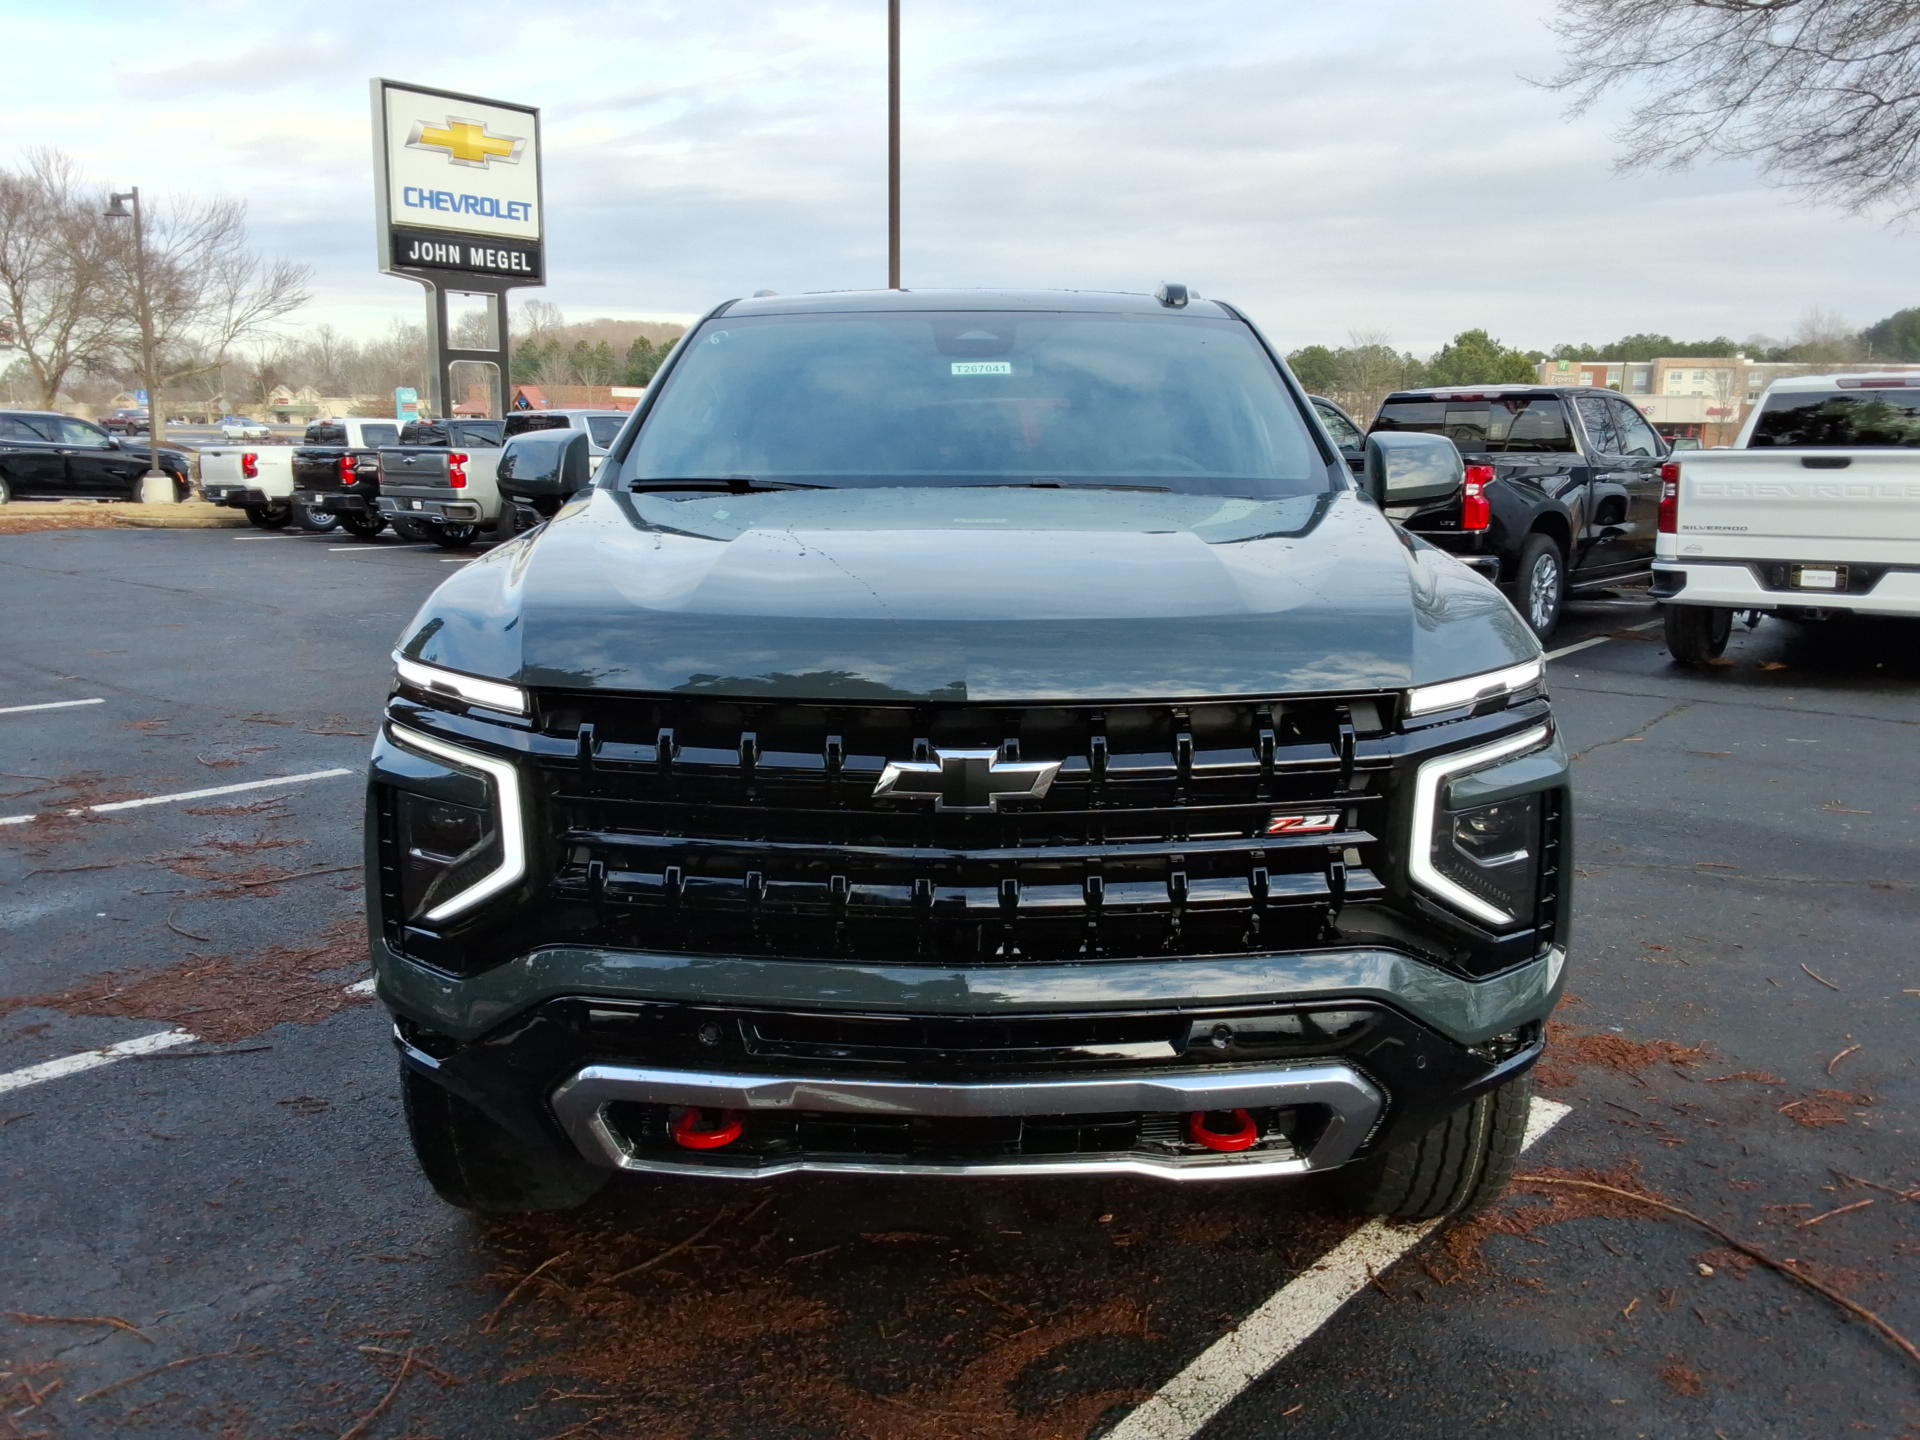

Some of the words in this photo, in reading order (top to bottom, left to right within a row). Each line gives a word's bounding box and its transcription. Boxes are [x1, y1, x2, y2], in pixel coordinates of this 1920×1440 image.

[403, 186, 532, 222] CHEVROLET
[409, 240, 460, 264] JOHN
[470, 247, 532, 271] MEGEL
[955, 364, 1007, 373] T267041
